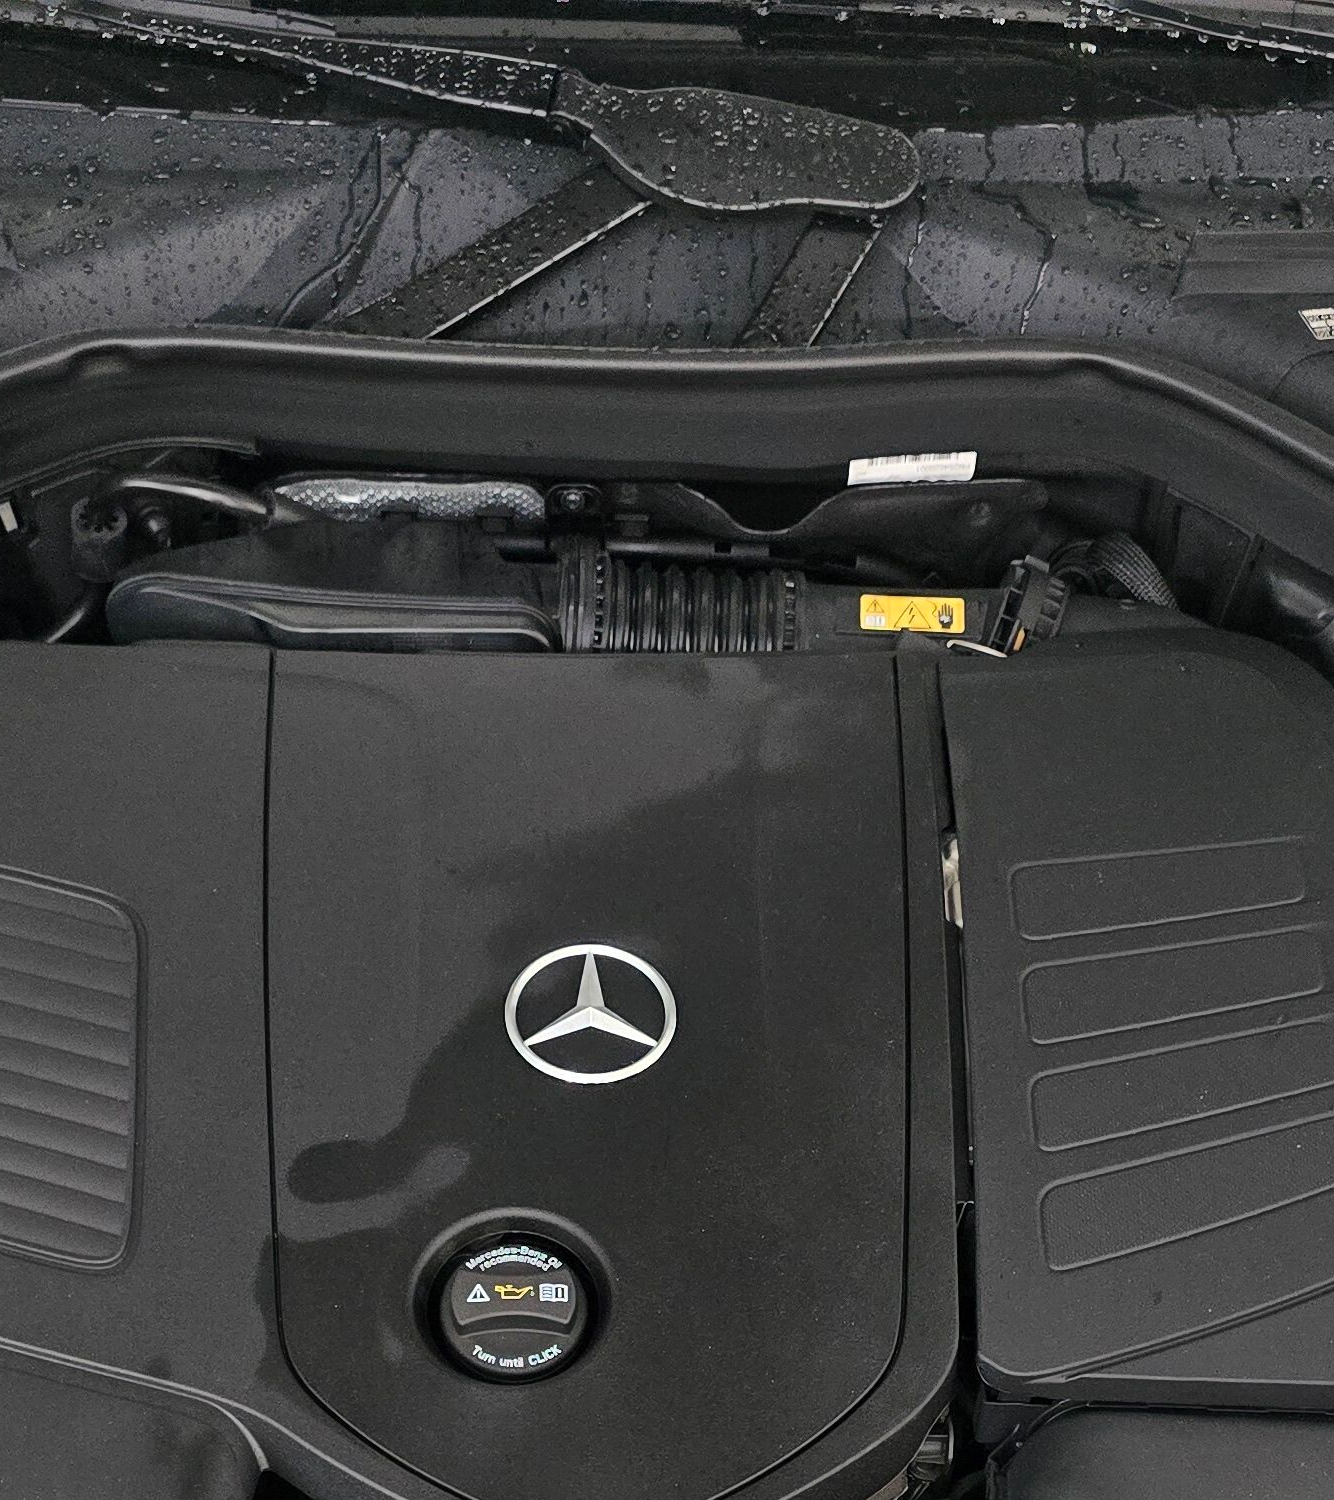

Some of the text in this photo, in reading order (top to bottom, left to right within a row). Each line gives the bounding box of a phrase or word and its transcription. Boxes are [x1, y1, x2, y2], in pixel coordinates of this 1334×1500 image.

[465, 1246, 548, 1270] Mercedes-Benz
[479, 1254, 551, 1271] recommended
[472, 1344, 563, 1368] Turn until CLICK
